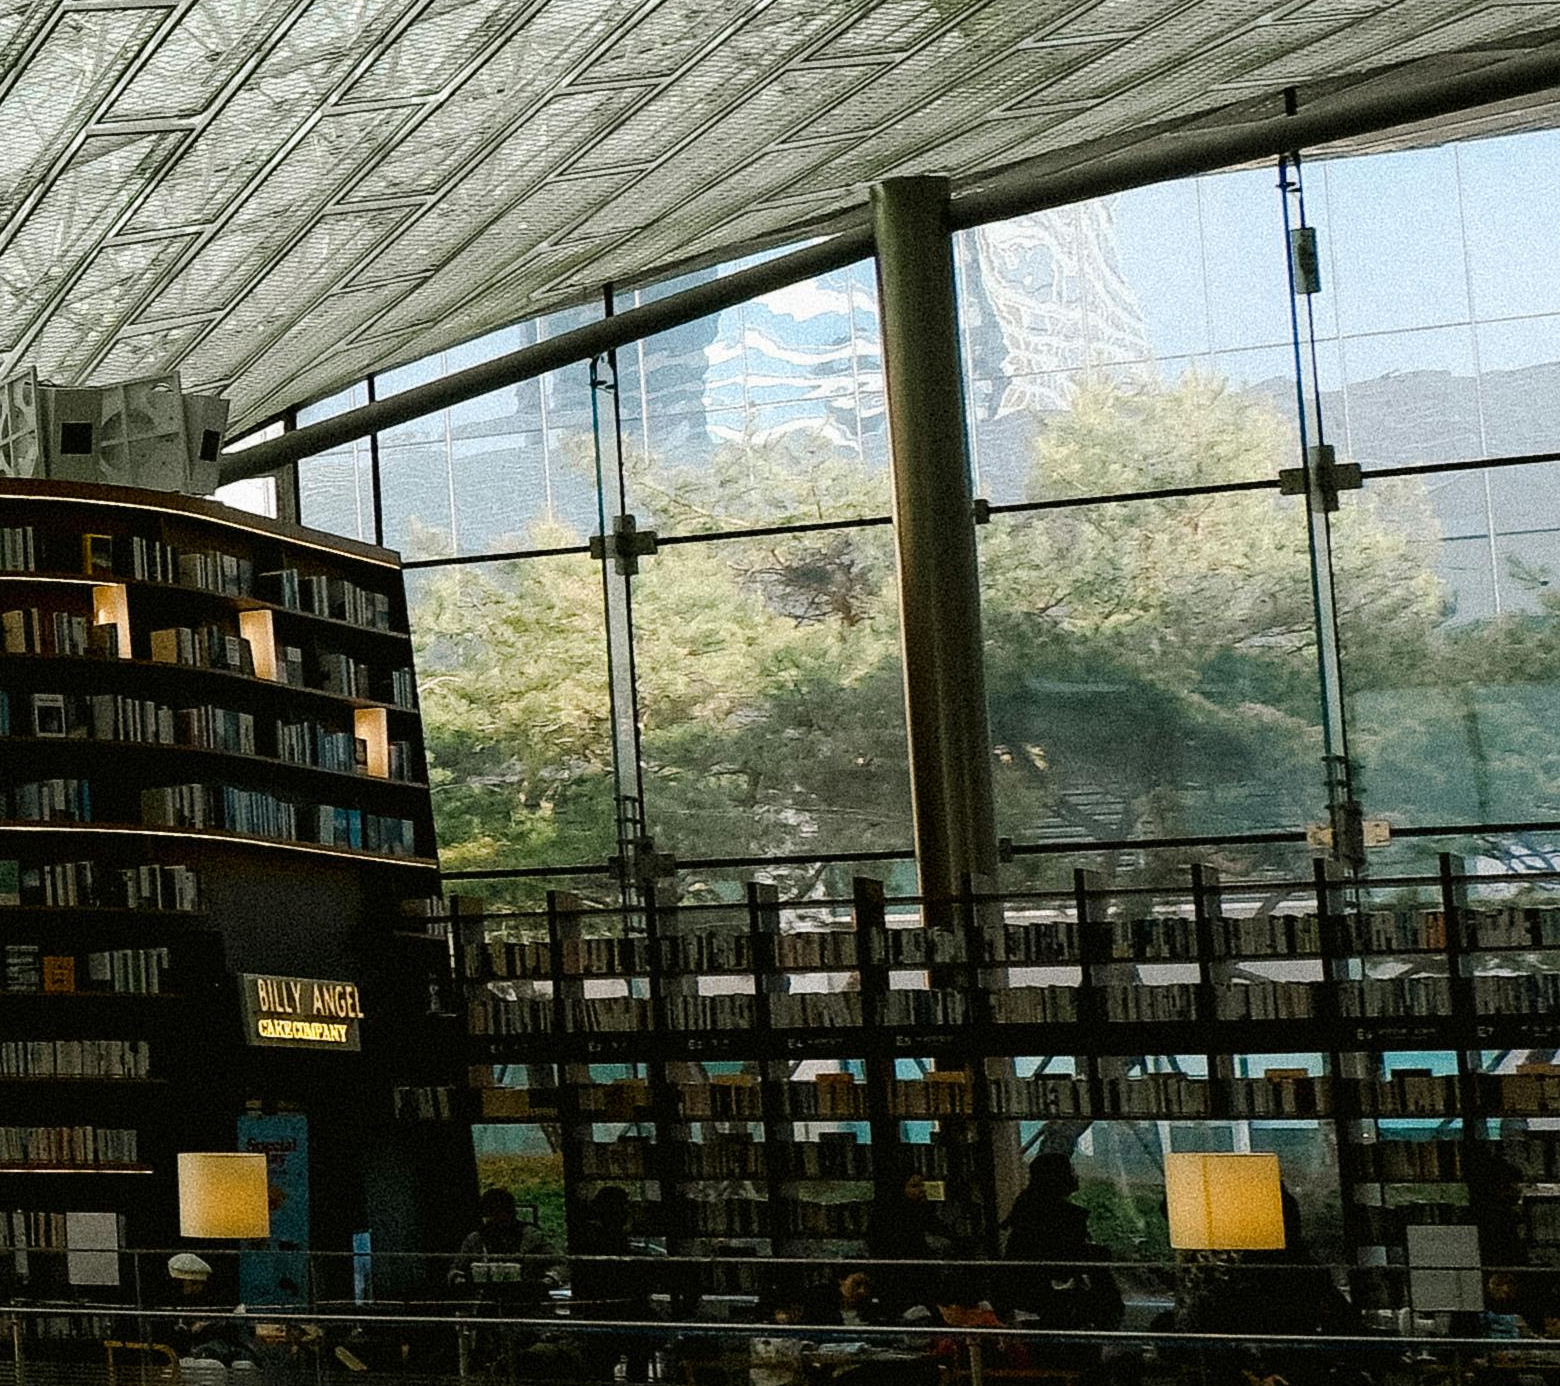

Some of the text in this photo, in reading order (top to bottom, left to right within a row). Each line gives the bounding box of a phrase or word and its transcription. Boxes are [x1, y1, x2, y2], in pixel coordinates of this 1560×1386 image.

[257, 979, 365, 1019] BILLY ANGEL
[258, 1018, 348, 1042] CAKE COMPANY
